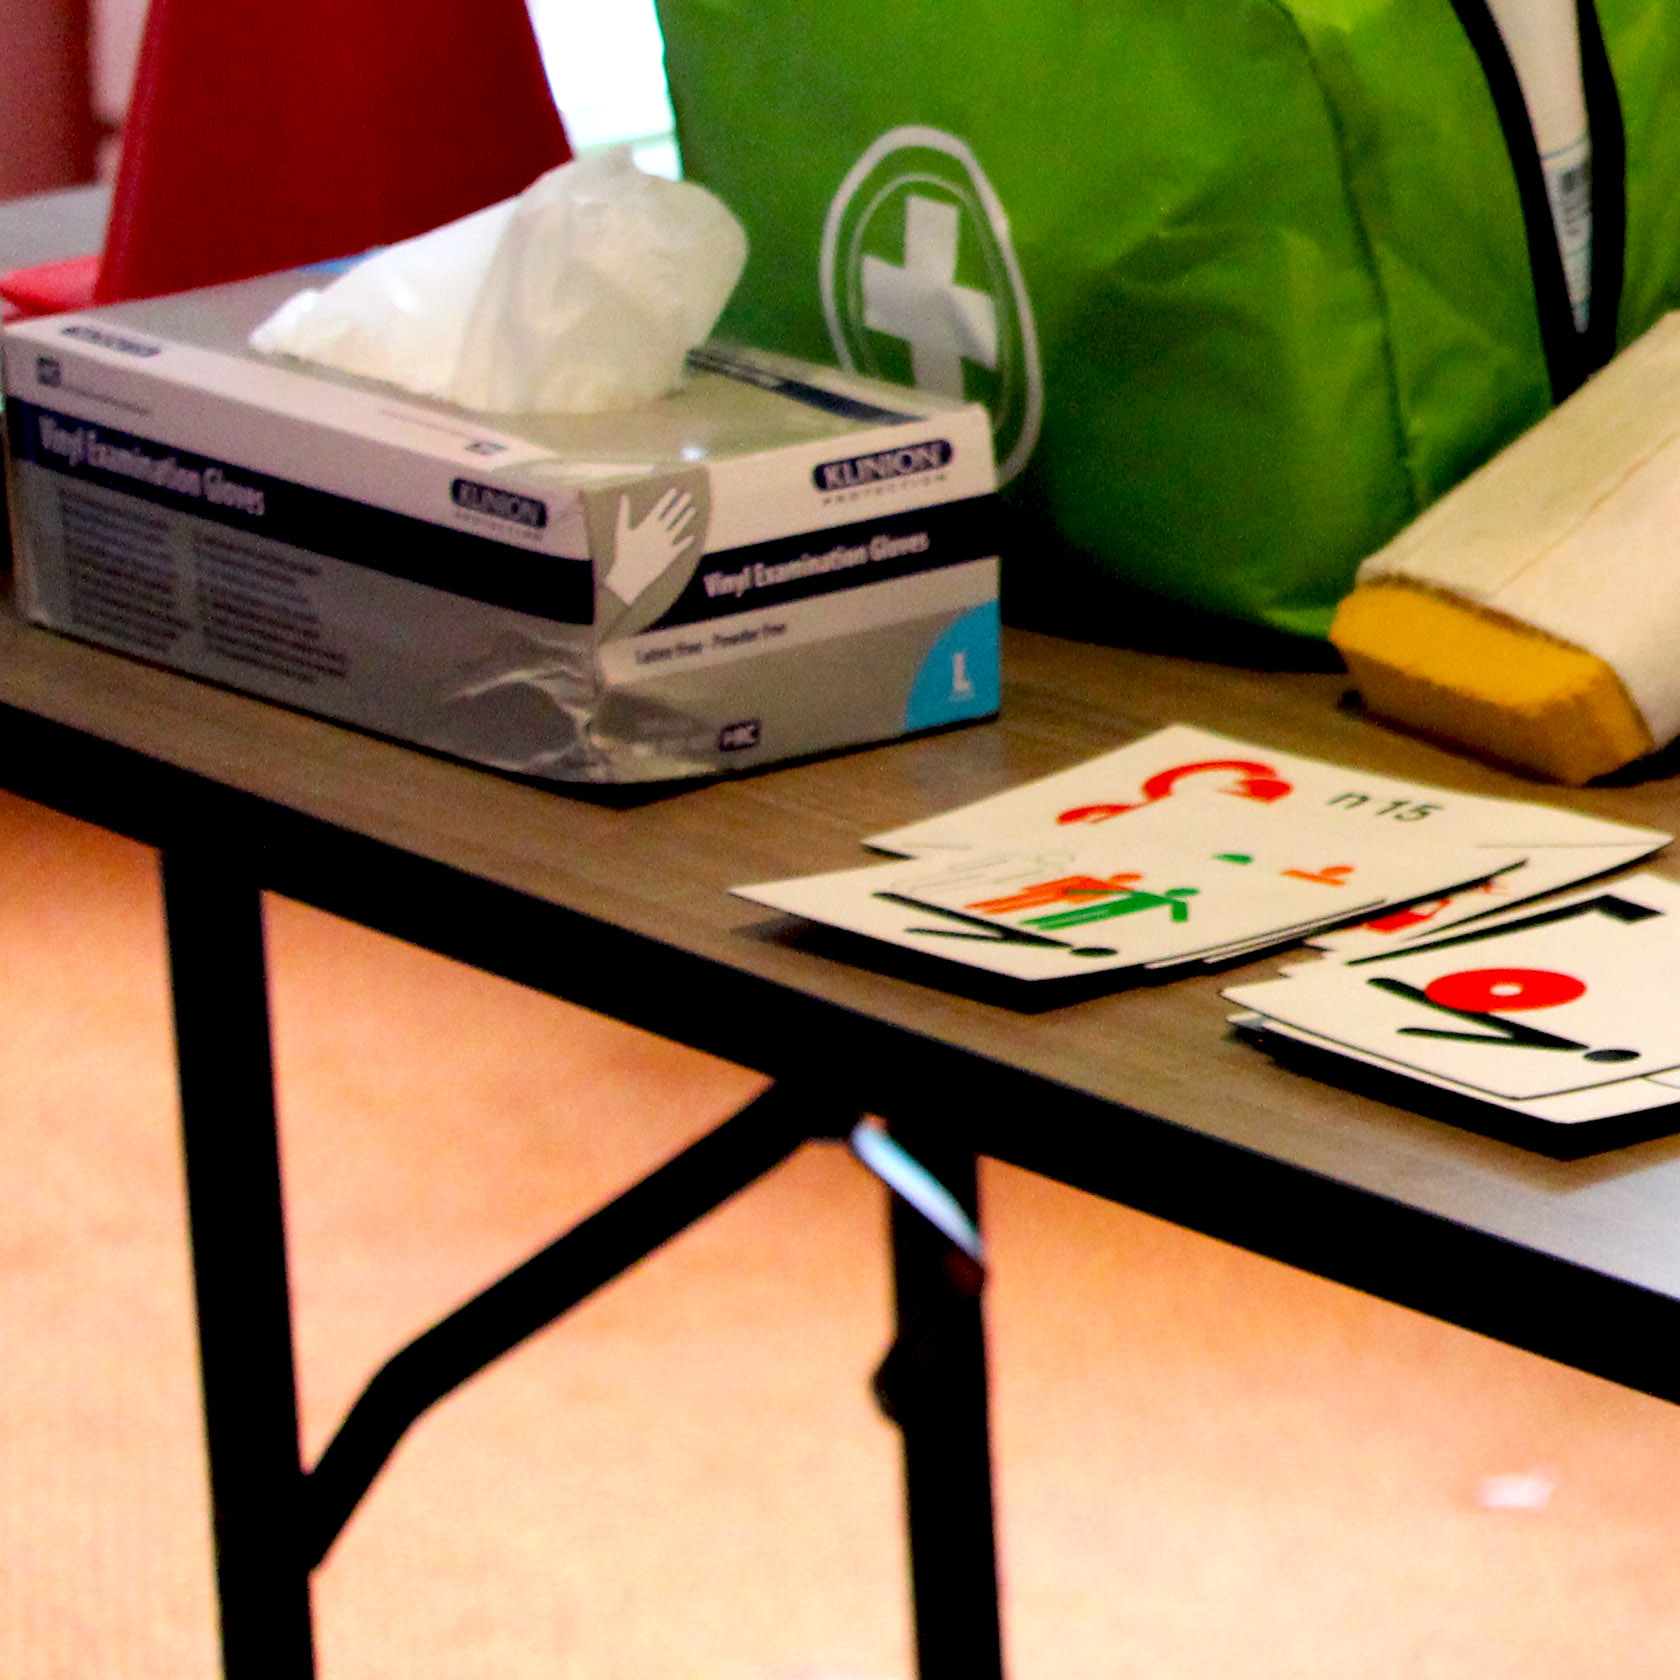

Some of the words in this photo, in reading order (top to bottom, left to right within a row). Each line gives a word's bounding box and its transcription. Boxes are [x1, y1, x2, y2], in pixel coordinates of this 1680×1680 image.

[823, 441, 944, 490] KLINION
[202, 467, 266, 517] Gloves
[703, 565, 751, 598] Vinyl
[753, 545, 869, 588] Examination
[869, 531, 930, 562] Gloves
[953, 653, 972, 691] L
